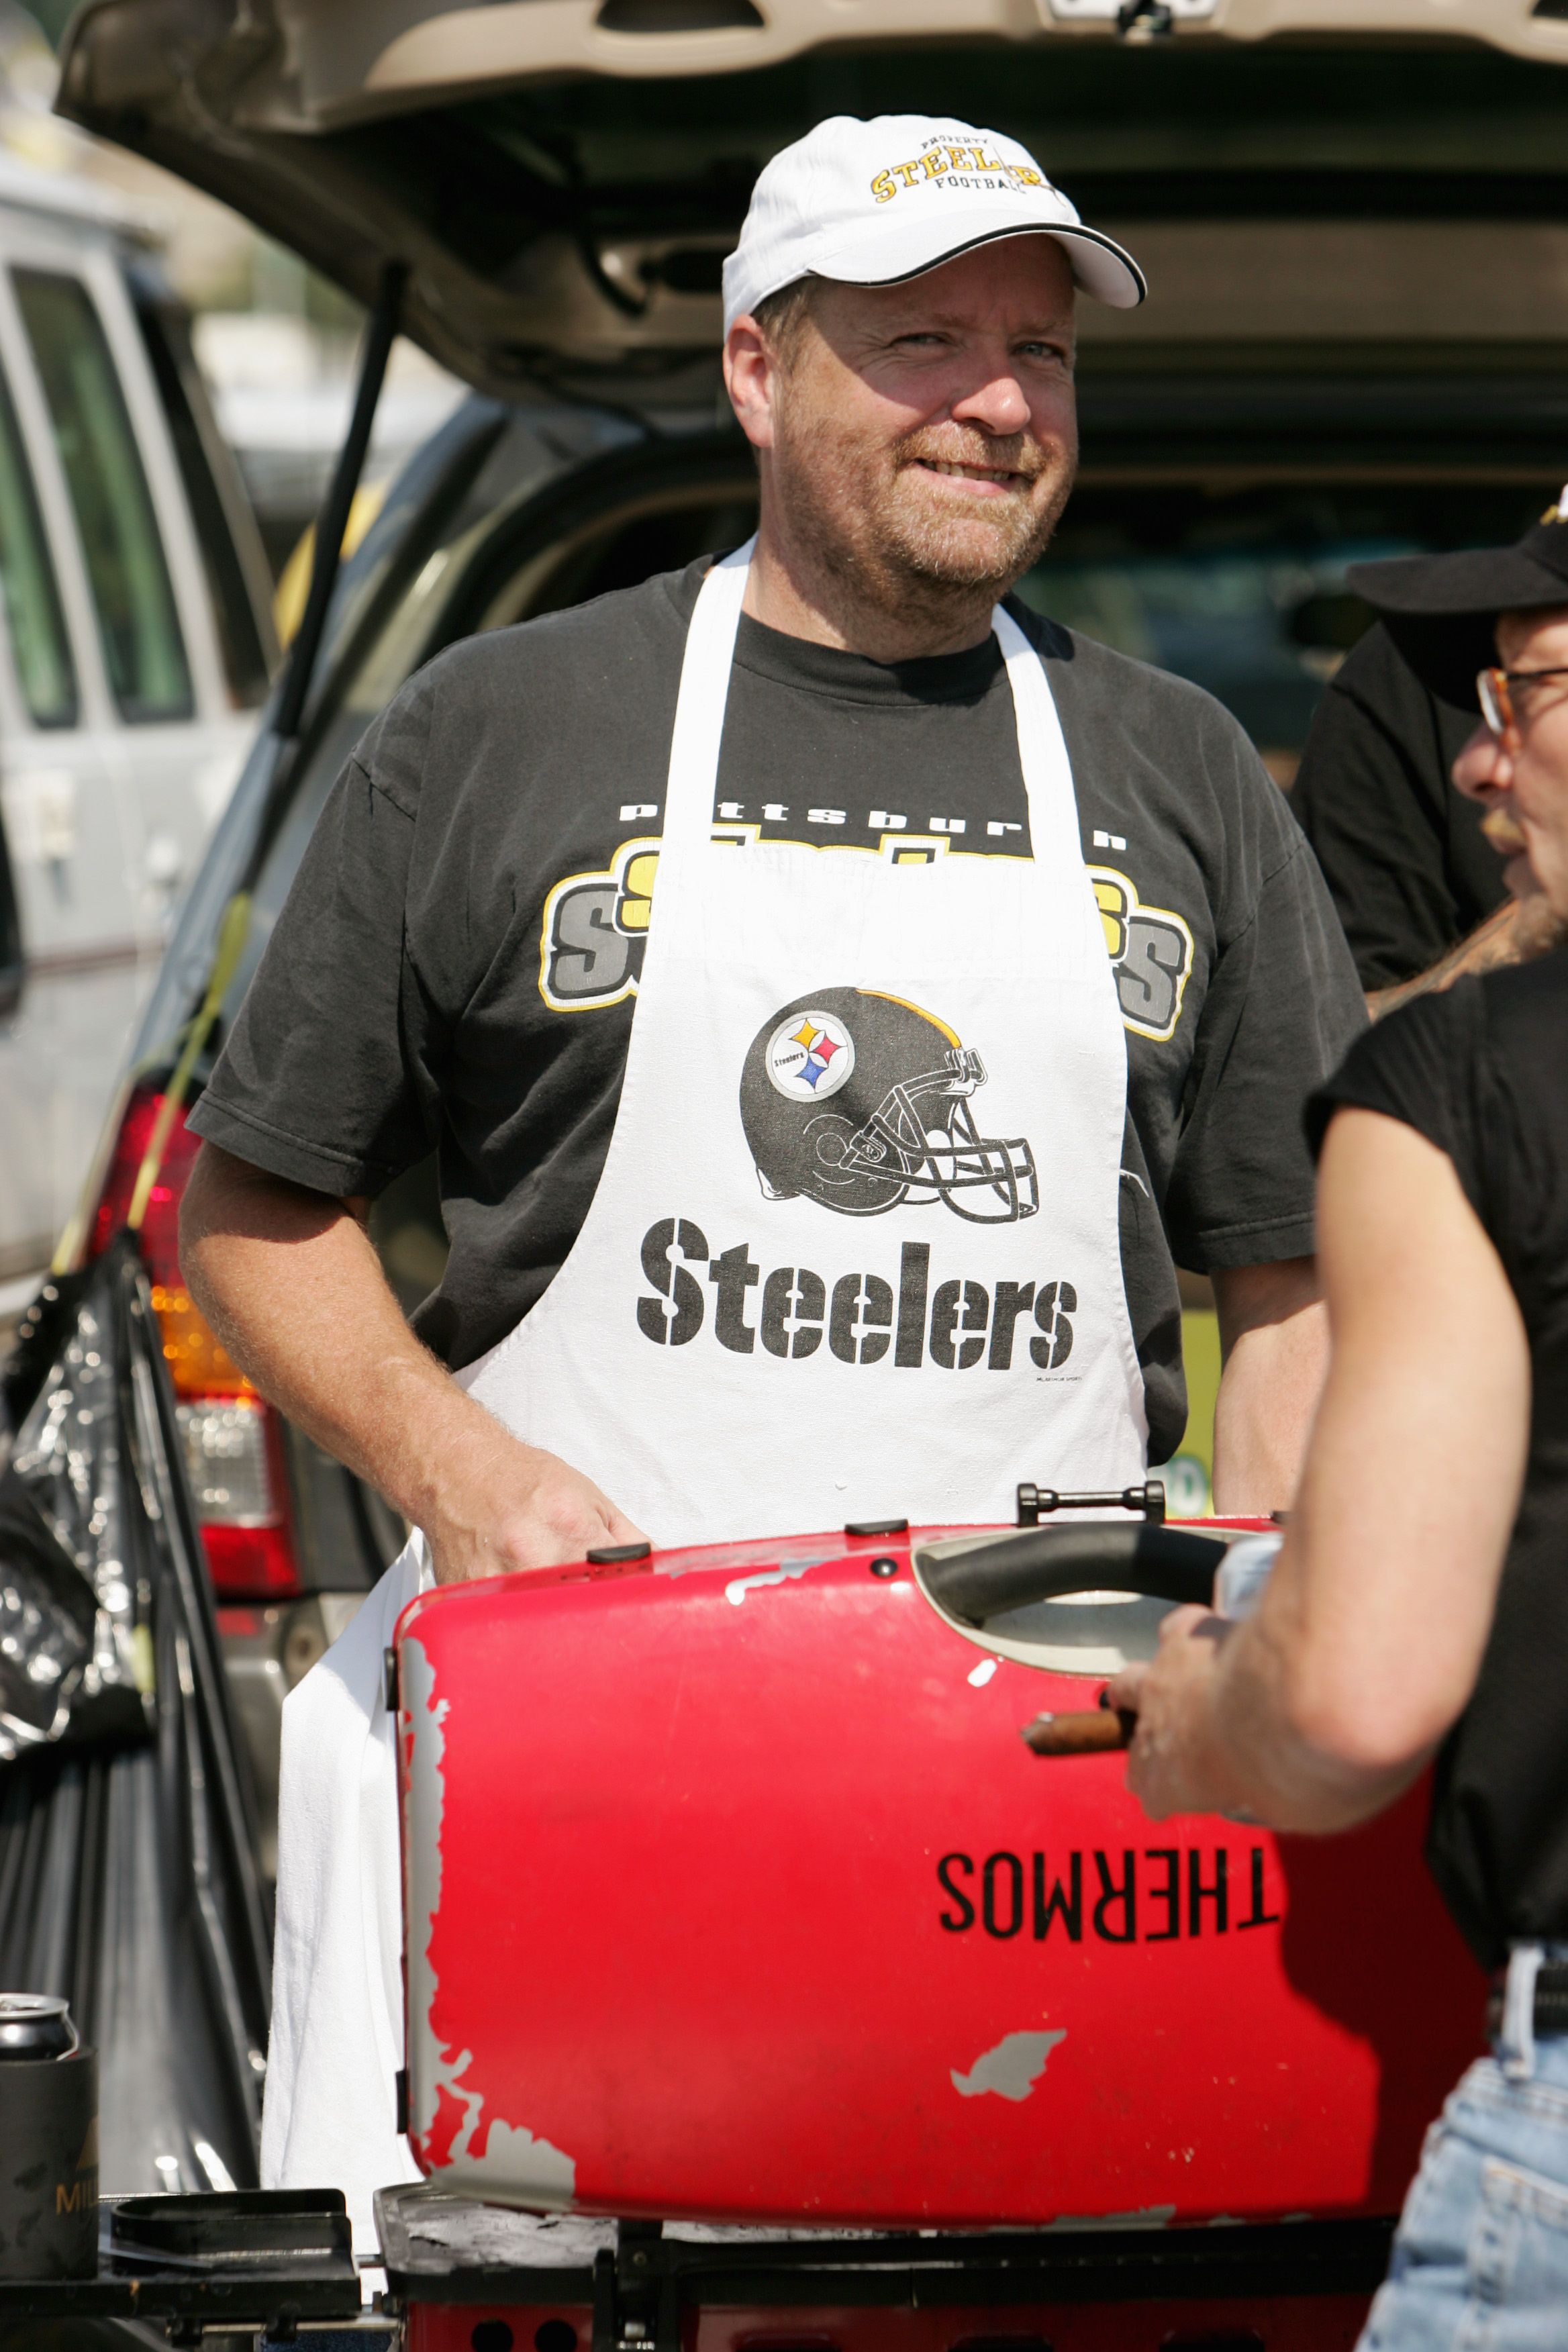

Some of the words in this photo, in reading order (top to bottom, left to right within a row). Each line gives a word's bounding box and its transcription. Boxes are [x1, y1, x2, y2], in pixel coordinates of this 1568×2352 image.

[935, 175, 1028, 195] FOOTBALL
[620, 801, 1127, 851] pttsburh
[774, 1051, 805, 1067] Steelers
[636, 1217, 1078, 1370] Steelers
[936, 1847, 1279, 1942] THERMOS
